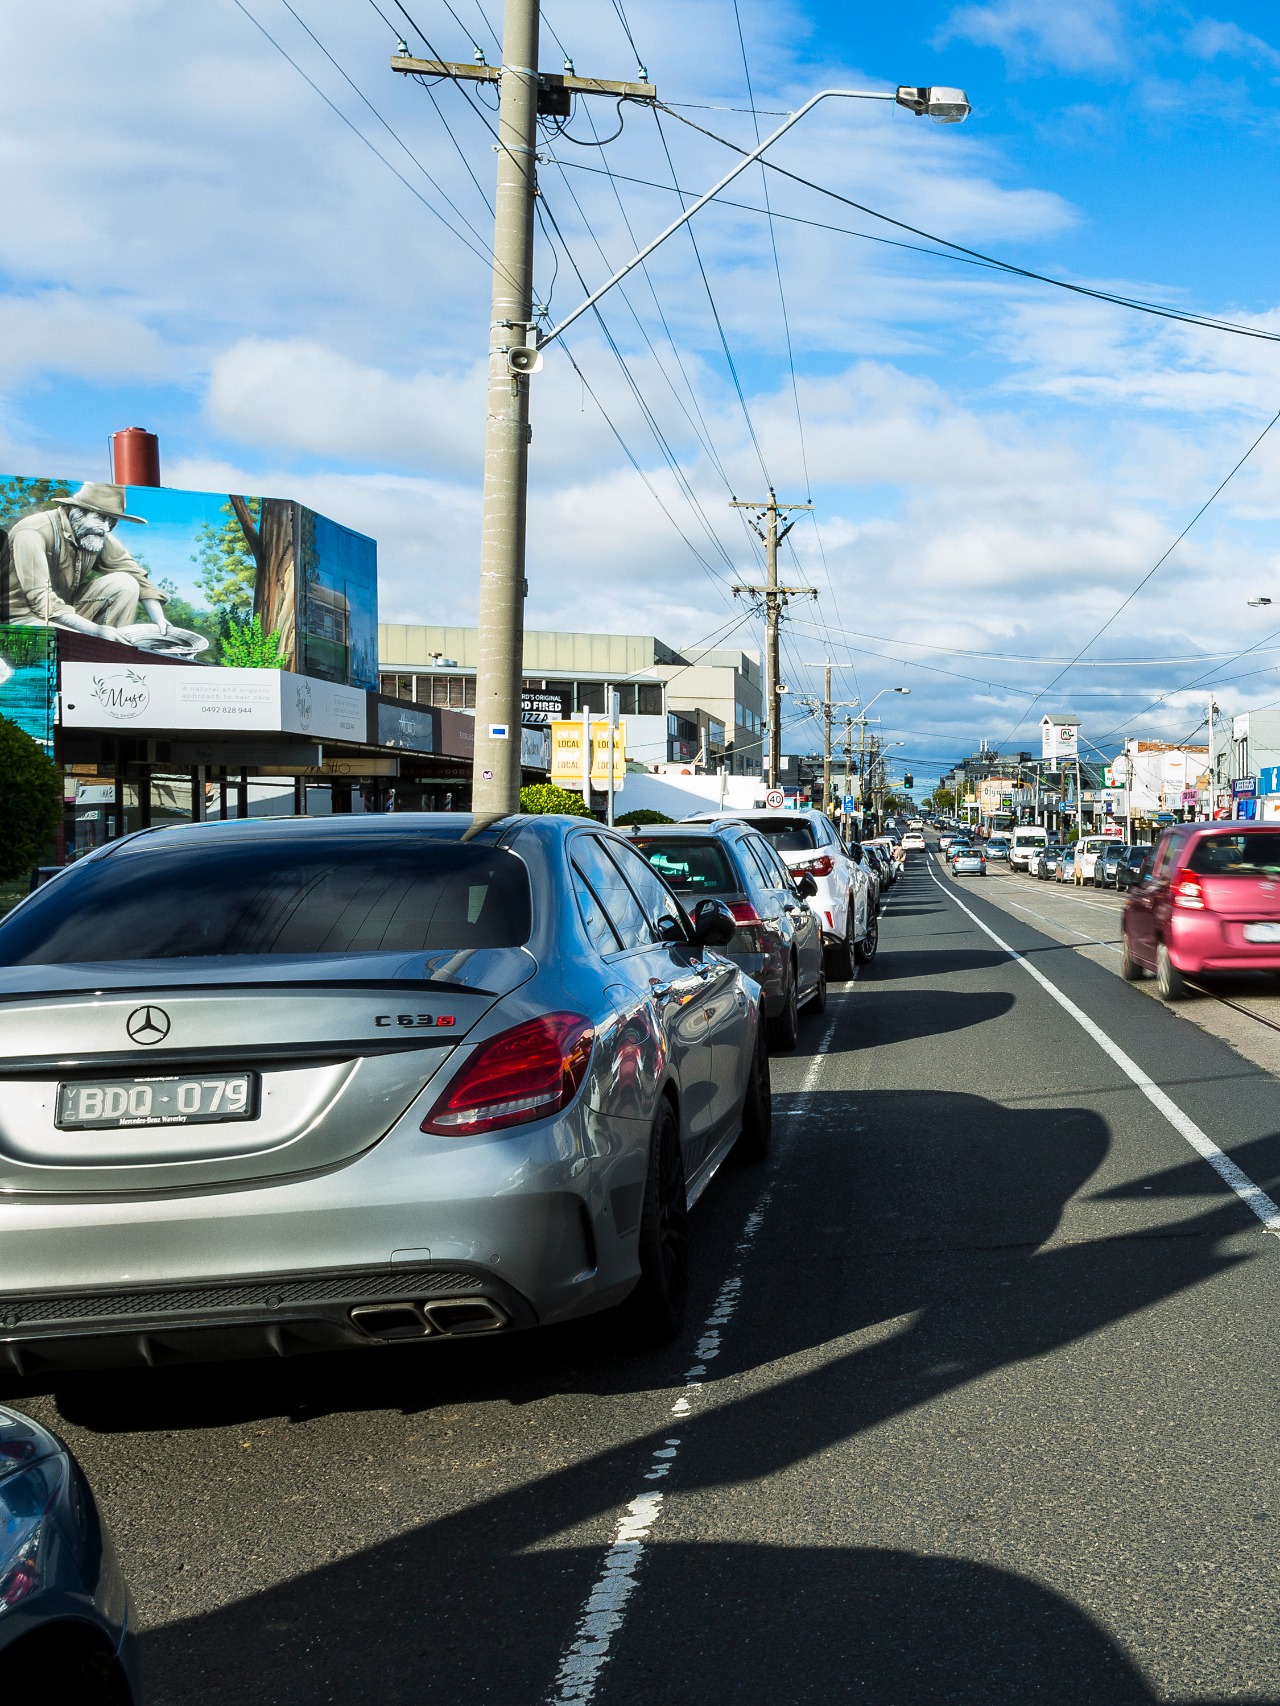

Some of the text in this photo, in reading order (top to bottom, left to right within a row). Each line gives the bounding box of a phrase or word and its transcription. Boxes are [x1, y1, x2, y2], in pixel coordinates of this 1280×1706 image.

[239, 687, 270, 695] organic
[103, 687, 147, 709] Muse
[182, 692, 221, 700] approach
[201, 706, 252, 714] 0492 828 944
[533, 702, 562, 711] FIRED
[522, 713, 548, 723] IZZA
[557, 740, 579, 748] LOCAL
[769, 795, 781, 804] 40
[78, 1079, 248, 1119] BDQ 079
[119, 1115, 187, 1125] Mercedes-Benz Waverley
